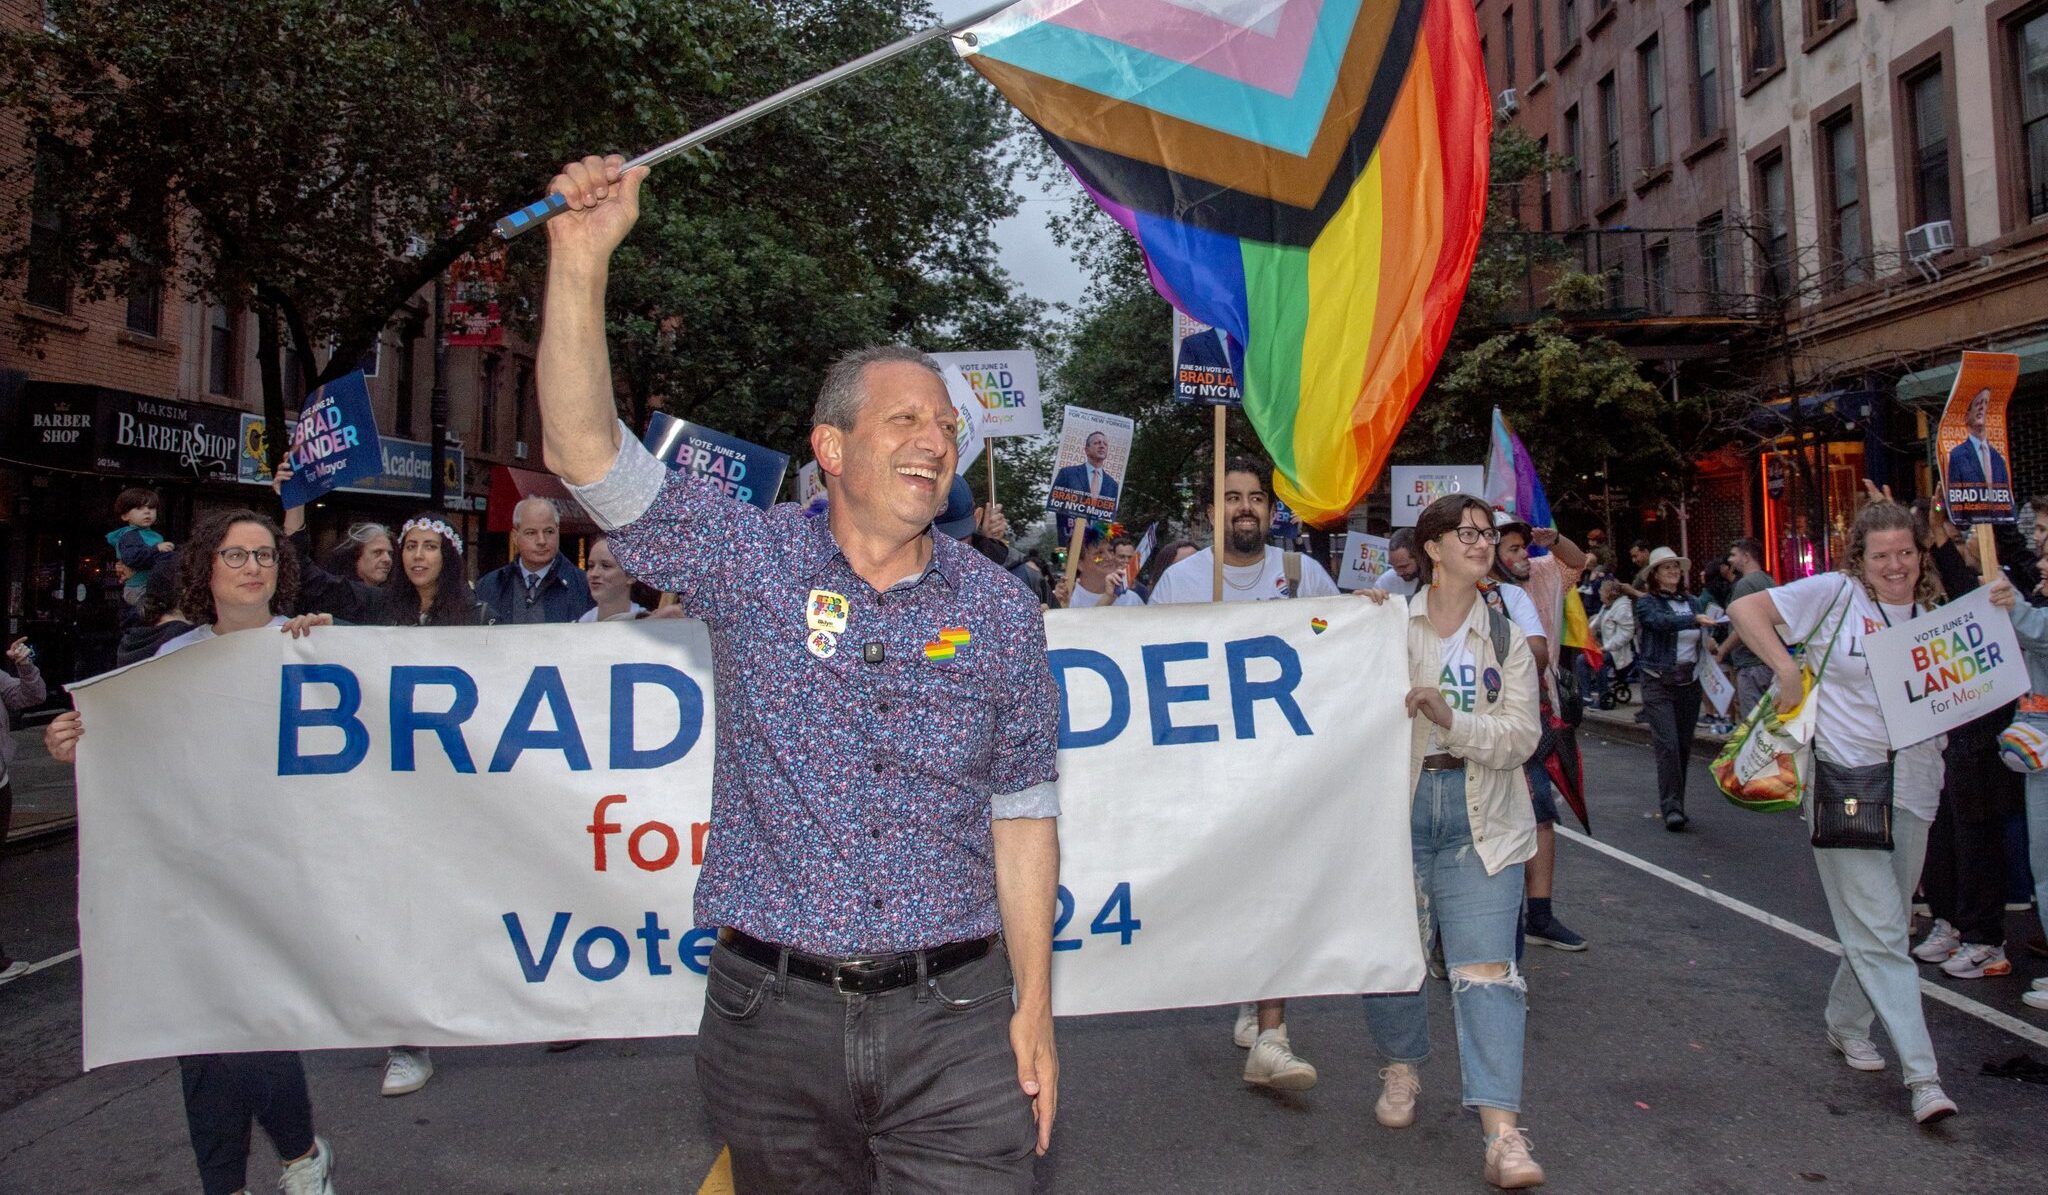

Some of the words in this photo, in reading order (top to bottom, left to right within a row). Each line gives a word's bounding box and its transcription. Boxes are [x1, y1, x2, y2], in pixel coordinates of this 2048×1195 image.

[960, 363, 980, 371] VOTE
[981, 363, 998, 371] JUNE
[1179, 371, 1215, 385] BRAD
[975, 390, 1026, 409] NDER
[1180, 383, 1197, 394] for
[1200, 384, 1227, 397] NYC
[137, 401, 187, 421] MAKSIM
[326, 396, 335, 406] 24
[33, 414, 91, 428] BARBER
[295, 406, 342, 446] BRAD
[982, 412, 1014, 425] Mayor
[1091, 416, 1105, 424] NEW
[42, 430, 80, 443] SHOP
[289, 425, 360, 471] LANDER
[689, 436, 713, 451] VOTE
[712, 445, 735, 458] JUNE
[735, 452, 747, 462] 24
[315, 458, 347, 477] Mayor
[382, 446, 432, 479] Academ
[675, 444, 747, 482] BRAD
[1415, 480, 1460, 494] BRAD
[1950, 488, 1978, 503] BRAD
[1979, 488, 2010, 503] LADER
[1050, 498, 1064, 508] for
[1065, 501, 1086, 513] NYC
[1086, 505, 1113, 518] Mayor
[1052, 489, 1078, 503] BRAD
[1080, 496, 1115, 510] LANDER
[1361, 548, 1386, 563] BRA
[1914, 627, 1941, 644] VOTE
[1941, 617, 1963, 635] JUNE
[1963, 611, 1974, 623] 24
[1911, 622, 1984, 673] BRAD
[1439, 663, 1477, 687] AD
[1904, 641, 2004, 704] LANDER
[277, 662, 705, 776] BRAD
[1048, 635, 1314, 749] DER
[1931, 699, 1954, 716] for
[1952, 679, 1994, 707] Mayor
[586, 794, 710, 872] for
[501, 911, 718, 983] Vote
[1051, 881, 1142, 952] 24
